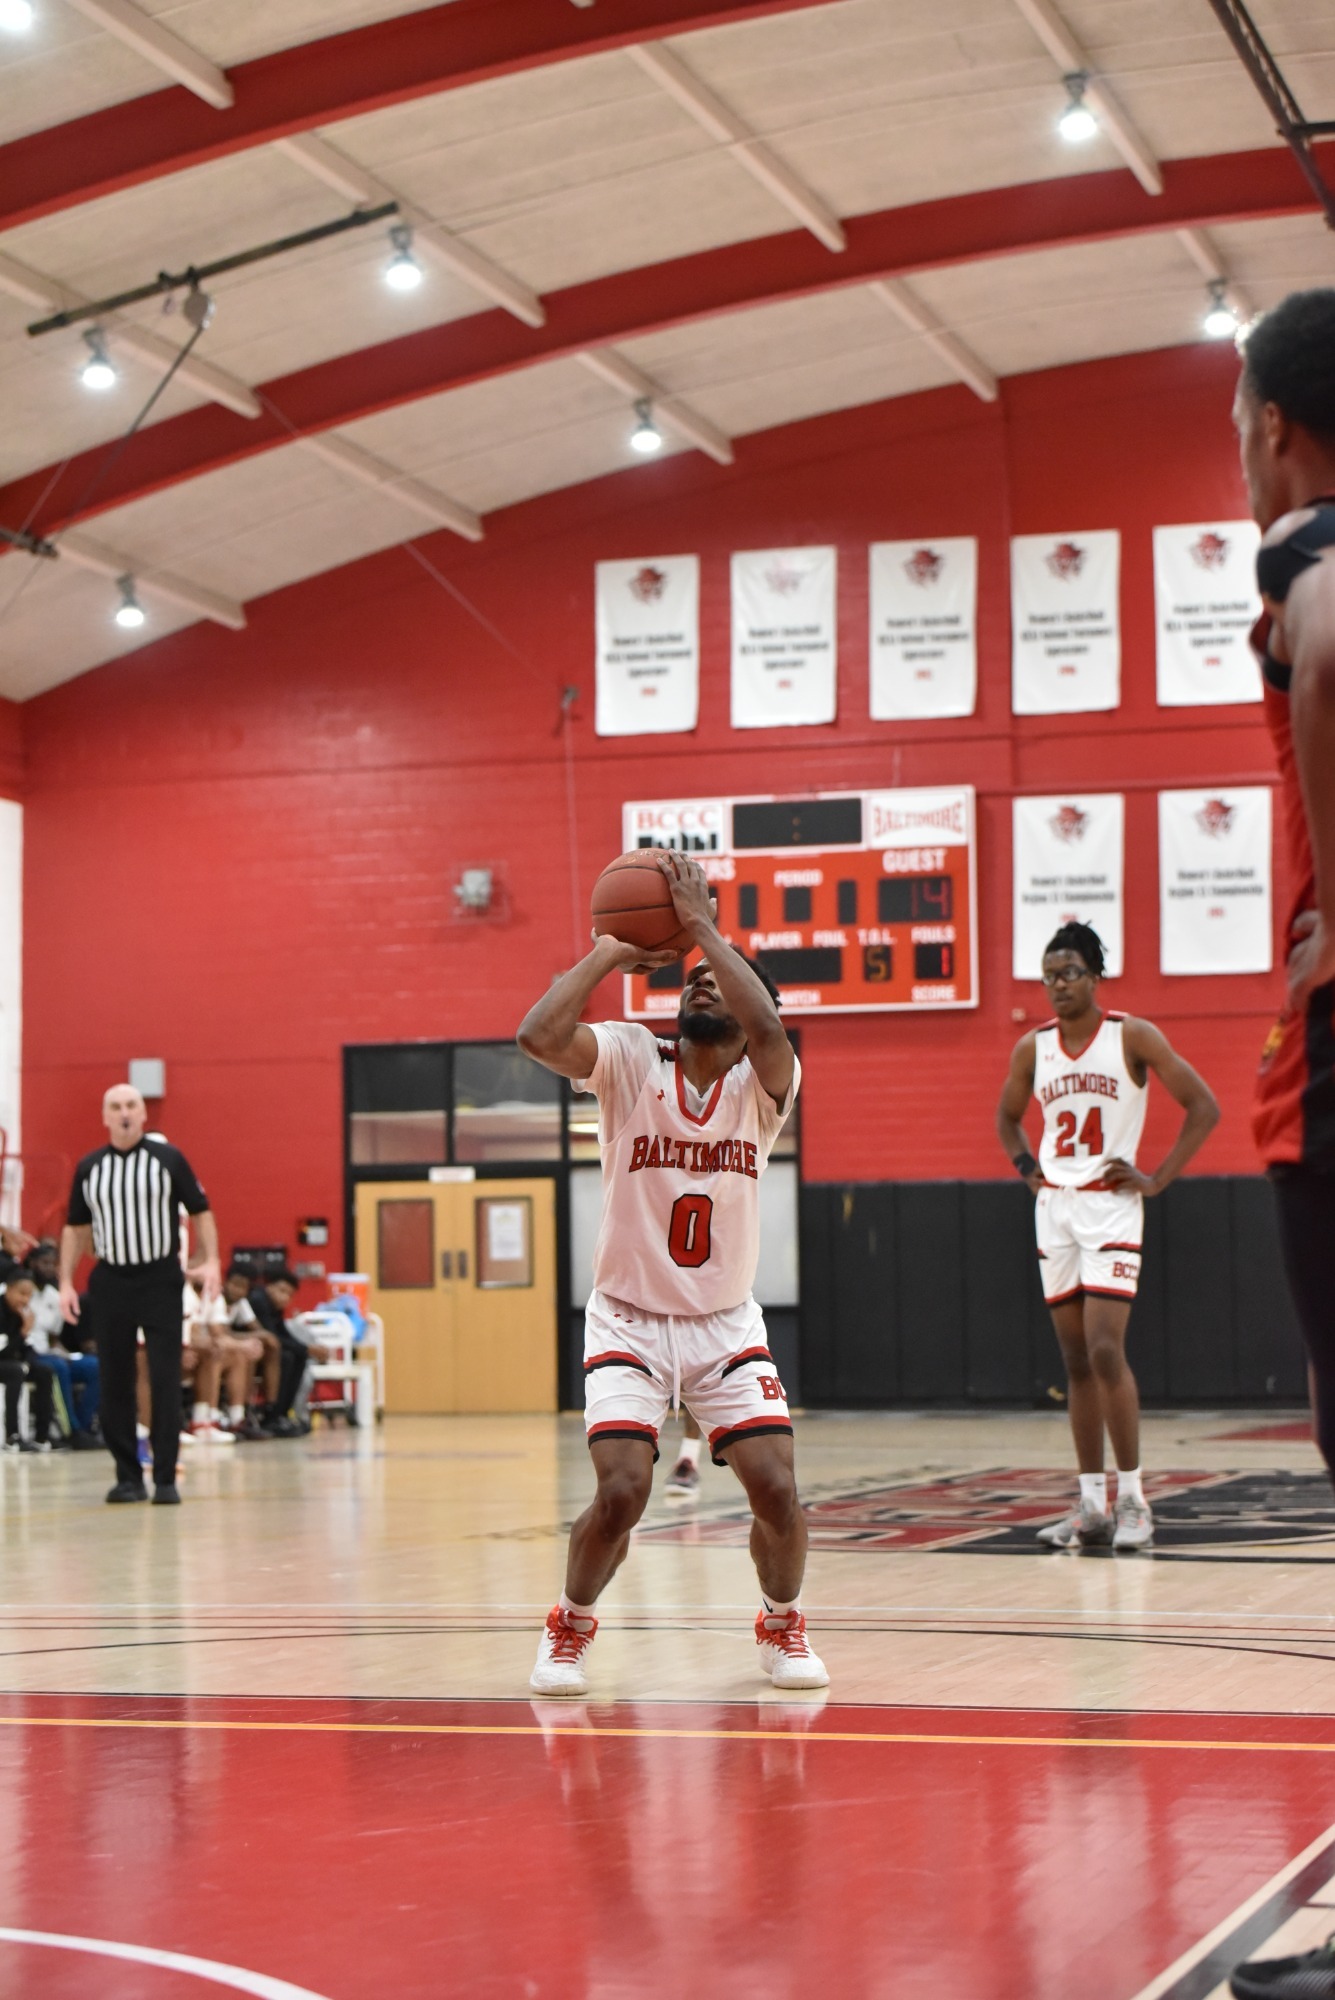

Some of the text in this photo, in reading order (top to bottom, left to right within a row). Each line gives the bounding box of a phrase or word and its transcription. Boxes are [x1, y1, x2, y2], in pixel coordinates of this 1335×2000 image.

[637, 806, 717, 830] BCCC
[874, 801, 963, 838] BALTIMORE
[882, 847, 946, 873] GUEST
[774, 869, 822, 888] PERIOD
[750, 931, 802, 949] PLAYER
[866, 946, 887, 981] 5
[1055, 1106, 1104, 1157] 24
[628, 1134, 758, 1180] BALTIMORE
[668, 1194, 713, 1268] 0
